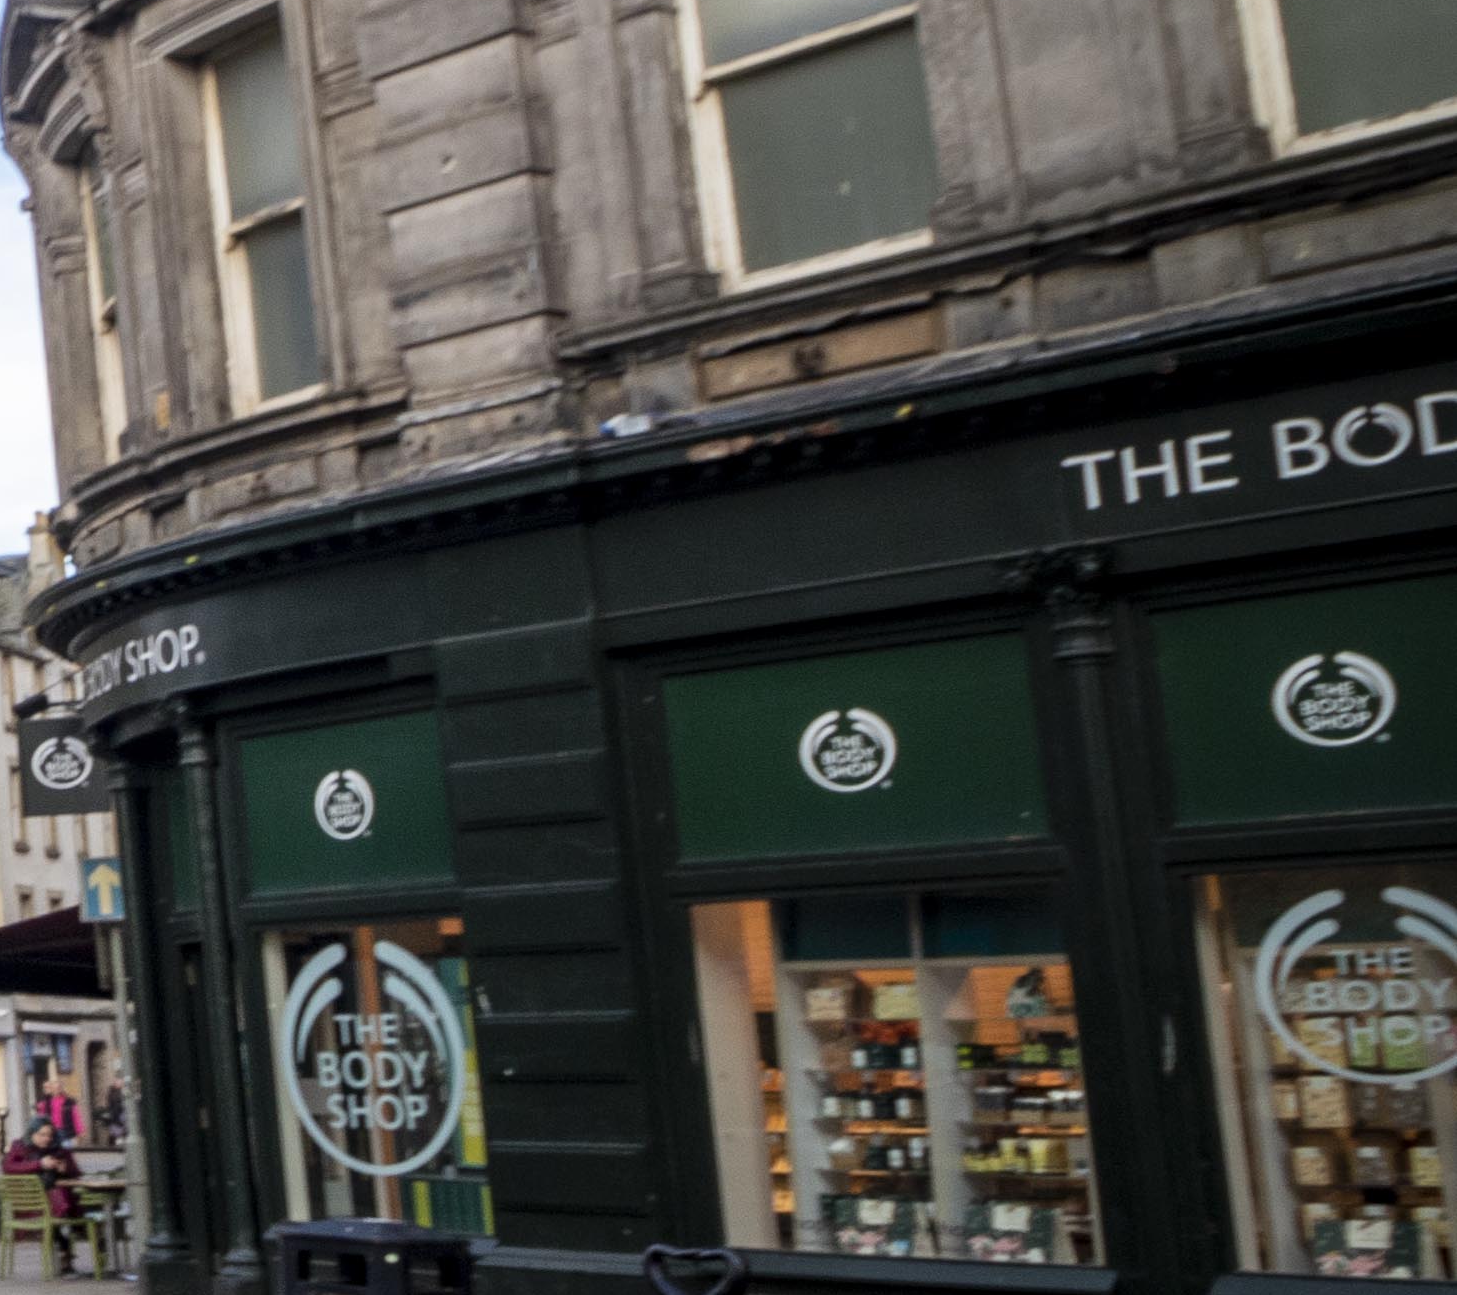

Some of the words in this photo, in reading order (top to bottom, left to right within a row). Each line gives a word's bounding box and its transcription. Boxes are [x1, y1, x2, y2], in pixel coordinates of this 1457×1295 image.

[1060, 429, 1240, 512] THE
[1330, 946, 1415, 976] THE
[1304, 978, 1454, 1011] BODY
[332, 1012, 400, 1047] THE
[1297, 1014, 1451, 1047] SHOP
[316, 1049, 430, 1090] BODY
[326, 1093, 429, 1131] SHOP
